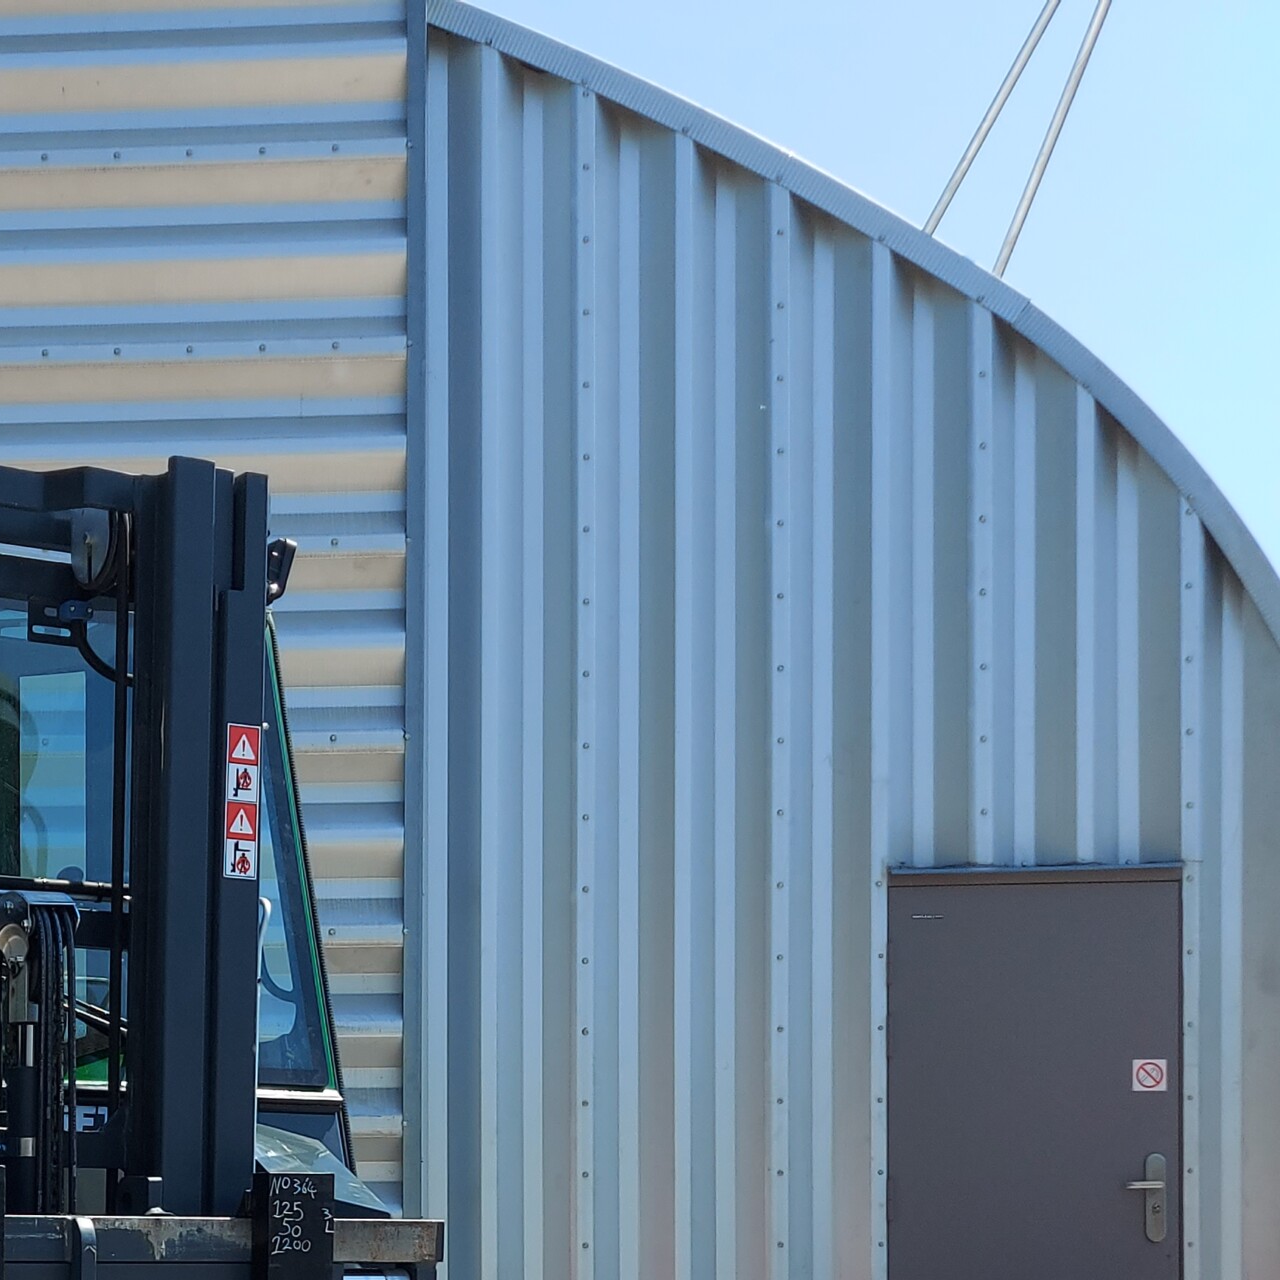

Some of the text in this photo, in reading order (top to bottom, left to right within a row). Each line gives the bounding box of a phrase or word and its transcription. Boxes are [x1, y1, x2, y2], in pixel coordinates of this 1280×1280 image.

[272, 1200, 304, 1221] 125
[278, 1217, 302, 1238] 50
[271, 1236, 312, 1255] 1200
